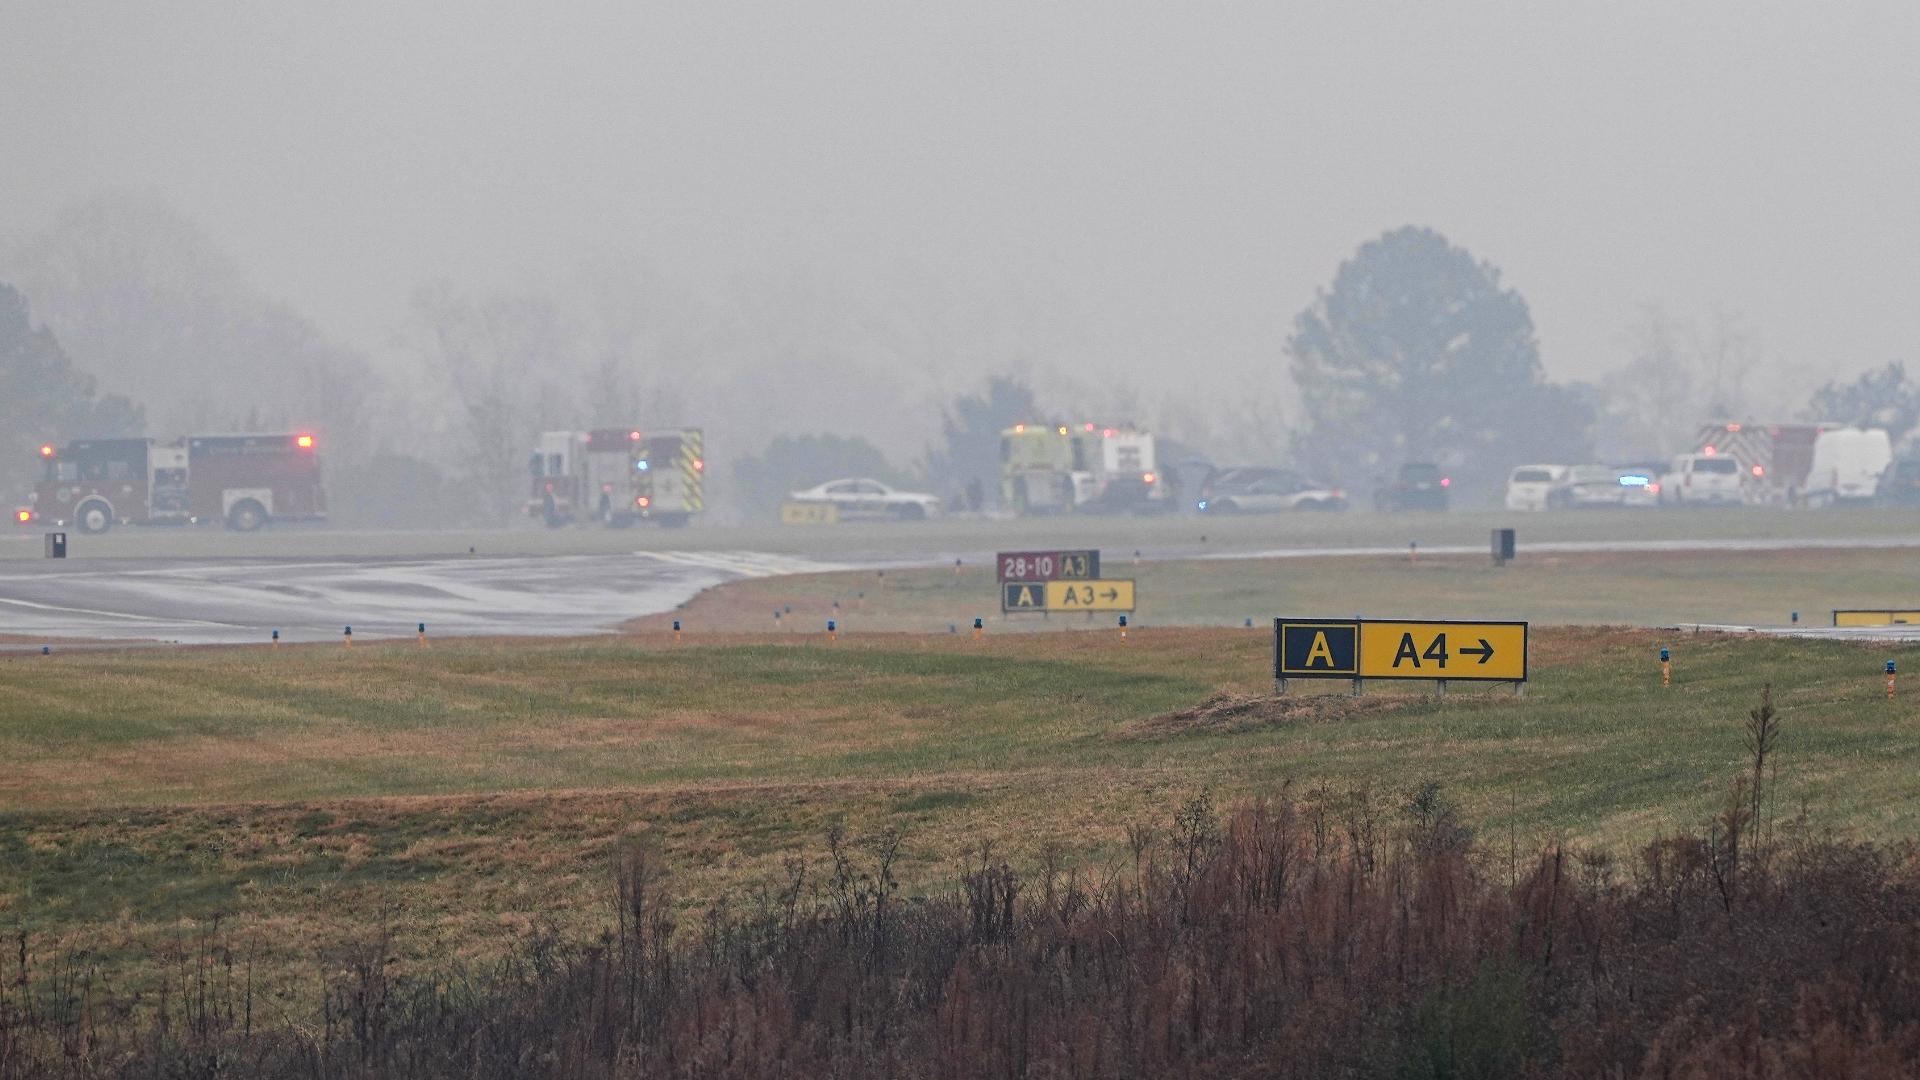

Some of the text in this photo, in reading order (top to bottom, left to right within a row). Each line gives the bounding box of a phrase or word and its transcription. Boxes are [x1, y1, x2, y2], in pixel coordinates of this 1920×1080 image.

[1005, 556, 1086, 578] 28-10 A3
[1017, 586, 1095, 606] A A3
[1305, 631, 1449, 669] A A4
